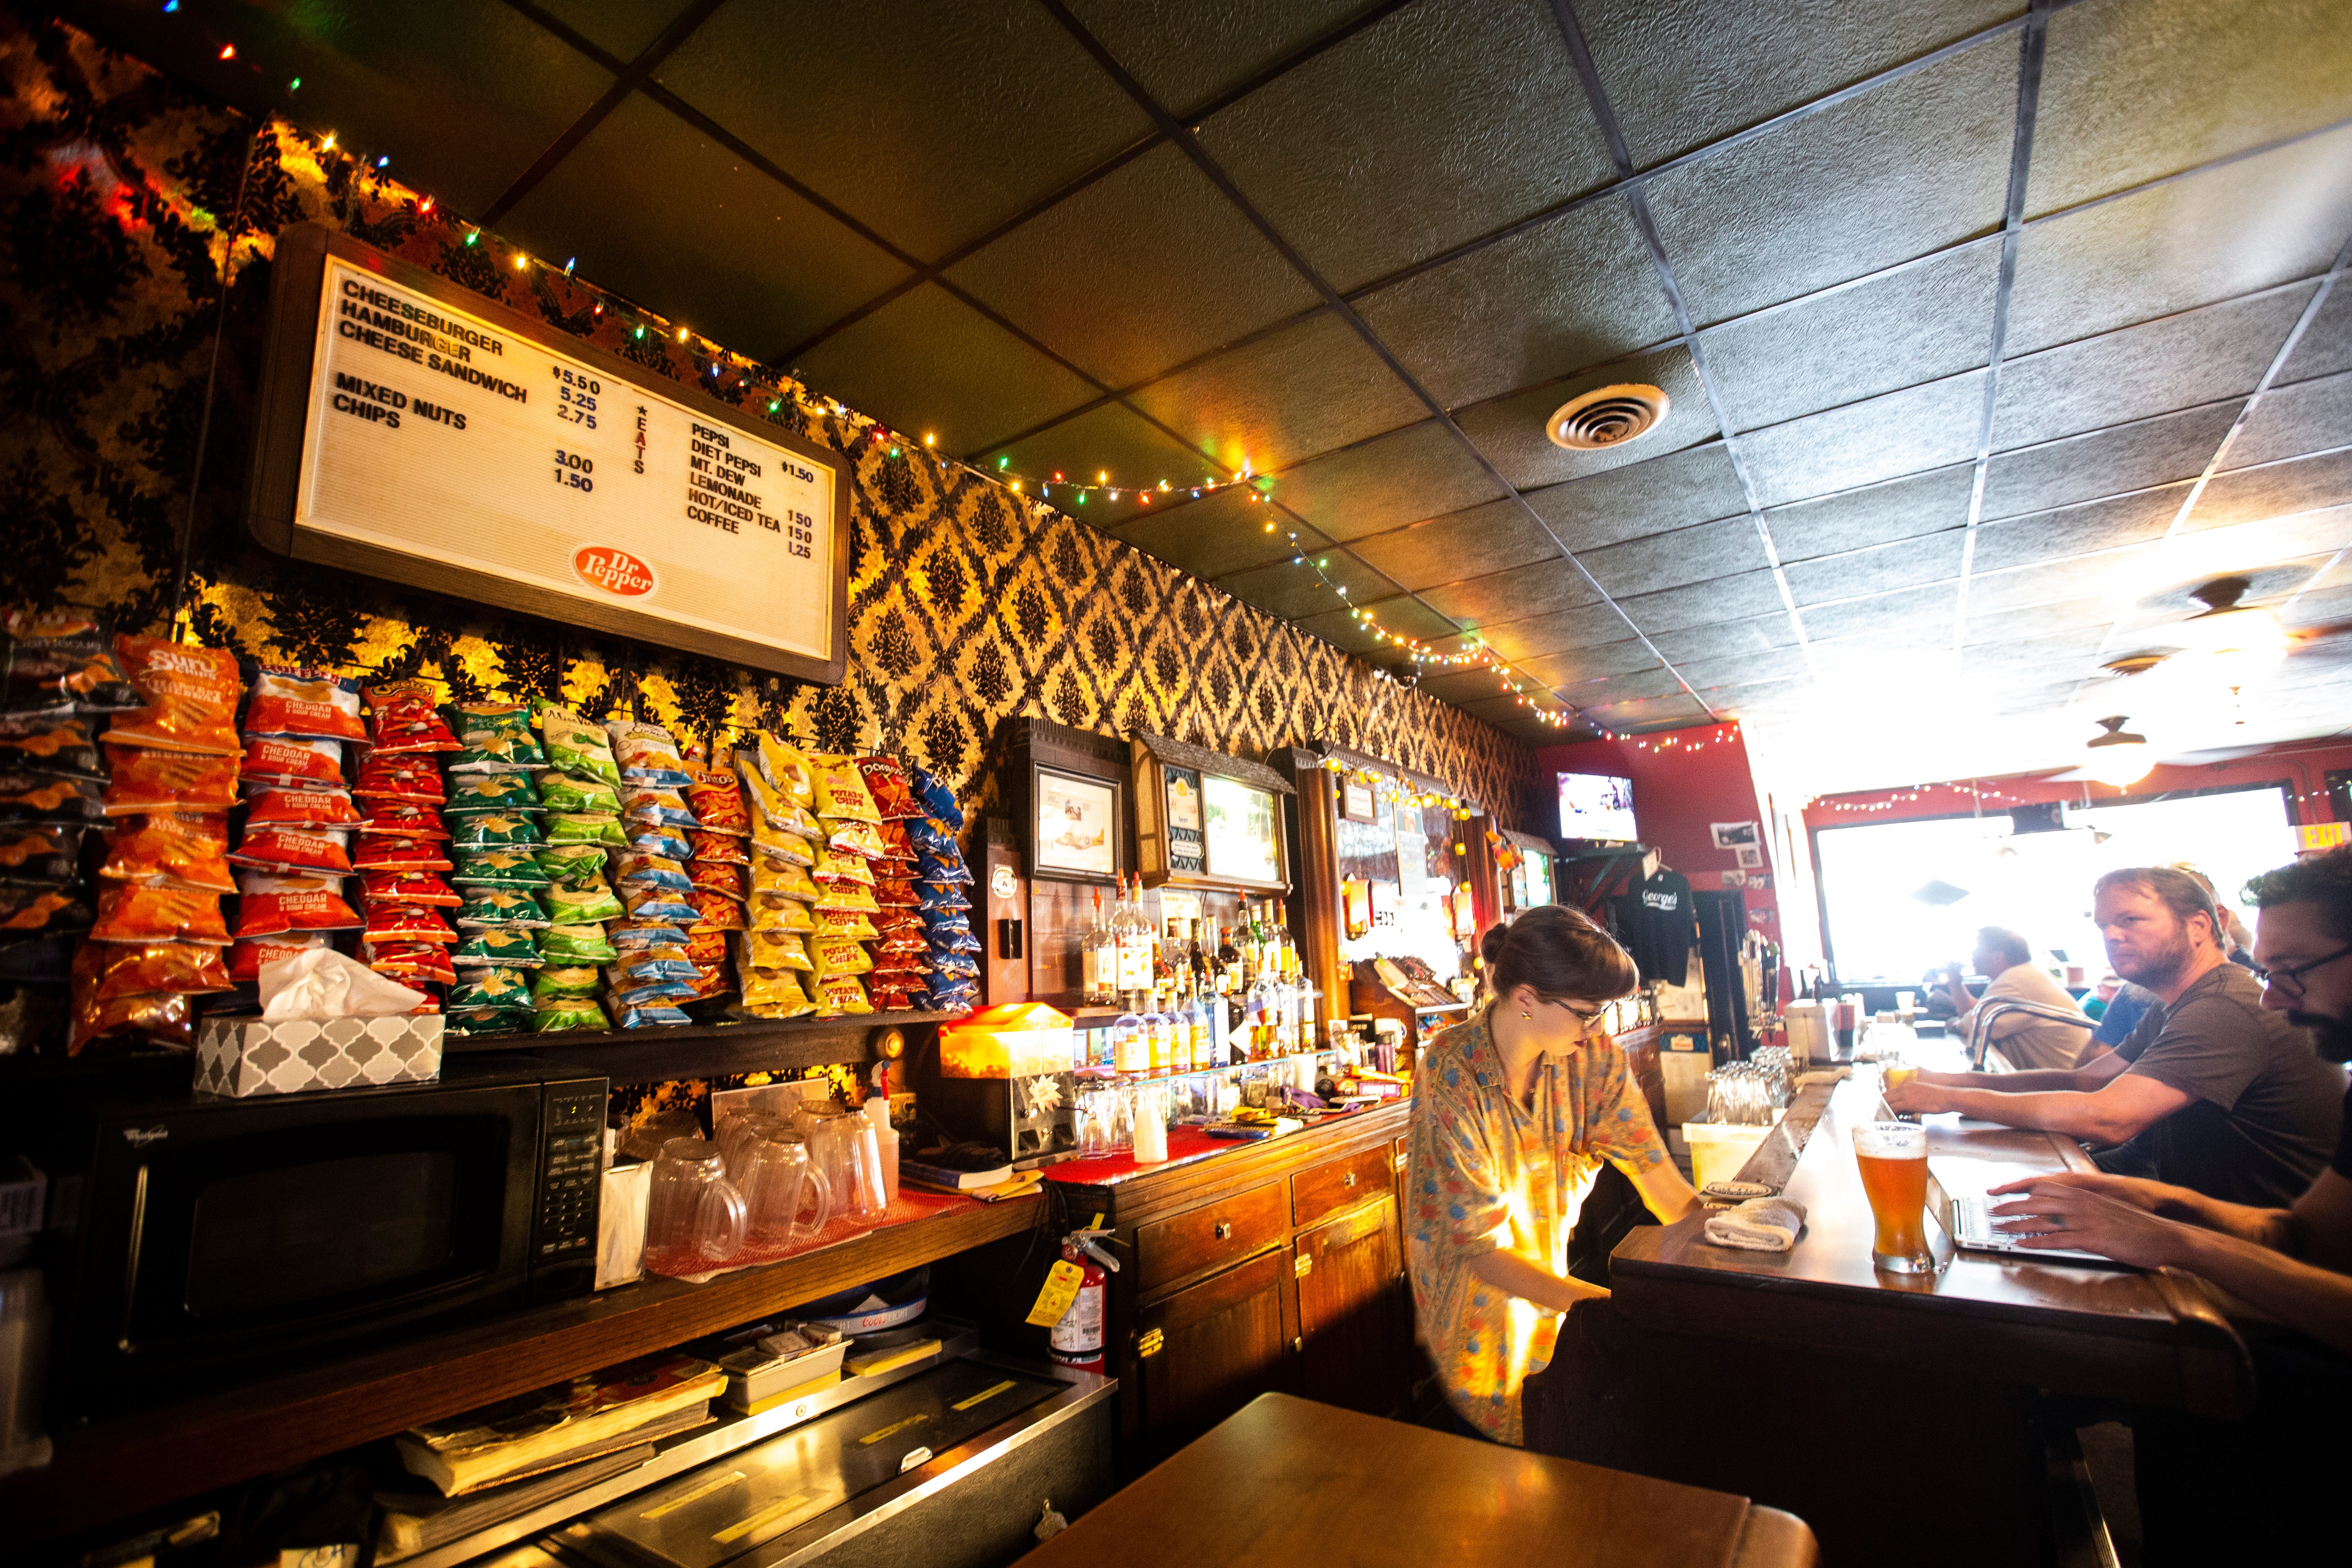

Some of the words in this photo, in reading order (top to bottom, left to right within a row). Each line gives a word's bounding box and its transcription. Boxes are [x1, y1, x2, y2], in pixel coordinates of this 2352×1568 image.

[343, 280, 503, 356] CHEESEBURGER
[552, 366, 600, 395] $5.50
[341, 299, 471, 363] HAMBURGER
[560, 386, 597, 411] 5.25
[339, 320, 423, 365] CHEESE
[428, 352, 527, 403] SANDWICH
[557, 405, 597, 430] 2.75
[336, 372, 408, 409] MIXED
[412, 399, 466, 430] NUTS
[555, 450, 593, 474] 3.00
[333, 393, 401, 429] CHIPS
[555, 469, 593, 492] 1.50
[692, 423, 729, 449] PEPSI
[692, 439, 722, 461] DIET
[725, 452, 761, 478] PEPSI
[782, 461, 813, 483] $1.50
[691, 455, 713, 476] MT.
[717, 465, 745, 487] DEW
[690, 472, 762, 510] LEMONADE
[688, 489, 753, 522] HOT/ICED
[757, 513, 780, 532] TEA
[687, 506, 739, 534] COFFEE
[608, 552, 639, 573] Dr
[584, 553, 653, 592] Pepper
[286, 701, 332, 713] CHEDDAR
[310, 711, 331, 719] CREAM
[263, 744, 310, 761] CHEDDAR
[287, 756, 309, 766] CREAM
[285, 795, 331, 805] CHEDDAR
[829, 789, 864, 799] POTATO
[835, 797, 864, 807] CHIPS
[278, 835, 325, 849] CHEDDAR
[2303, 824, 2344, 850] EXIT
[301, 845, 324, 855] CREAM
[278, 893, 327, 905] CHEDDAR
[829, 886, 860, 895] CHIPS
[1642, 889, 1677, 907] George's
[822, 945, 858, 956] POTATO
[828, 953, 858, 964] CHIPS
[824, 986, 860, 996] POTATO
[829, 994, 860, 1006] CHIPS
[862, 1315, 886, 1328] Coors
